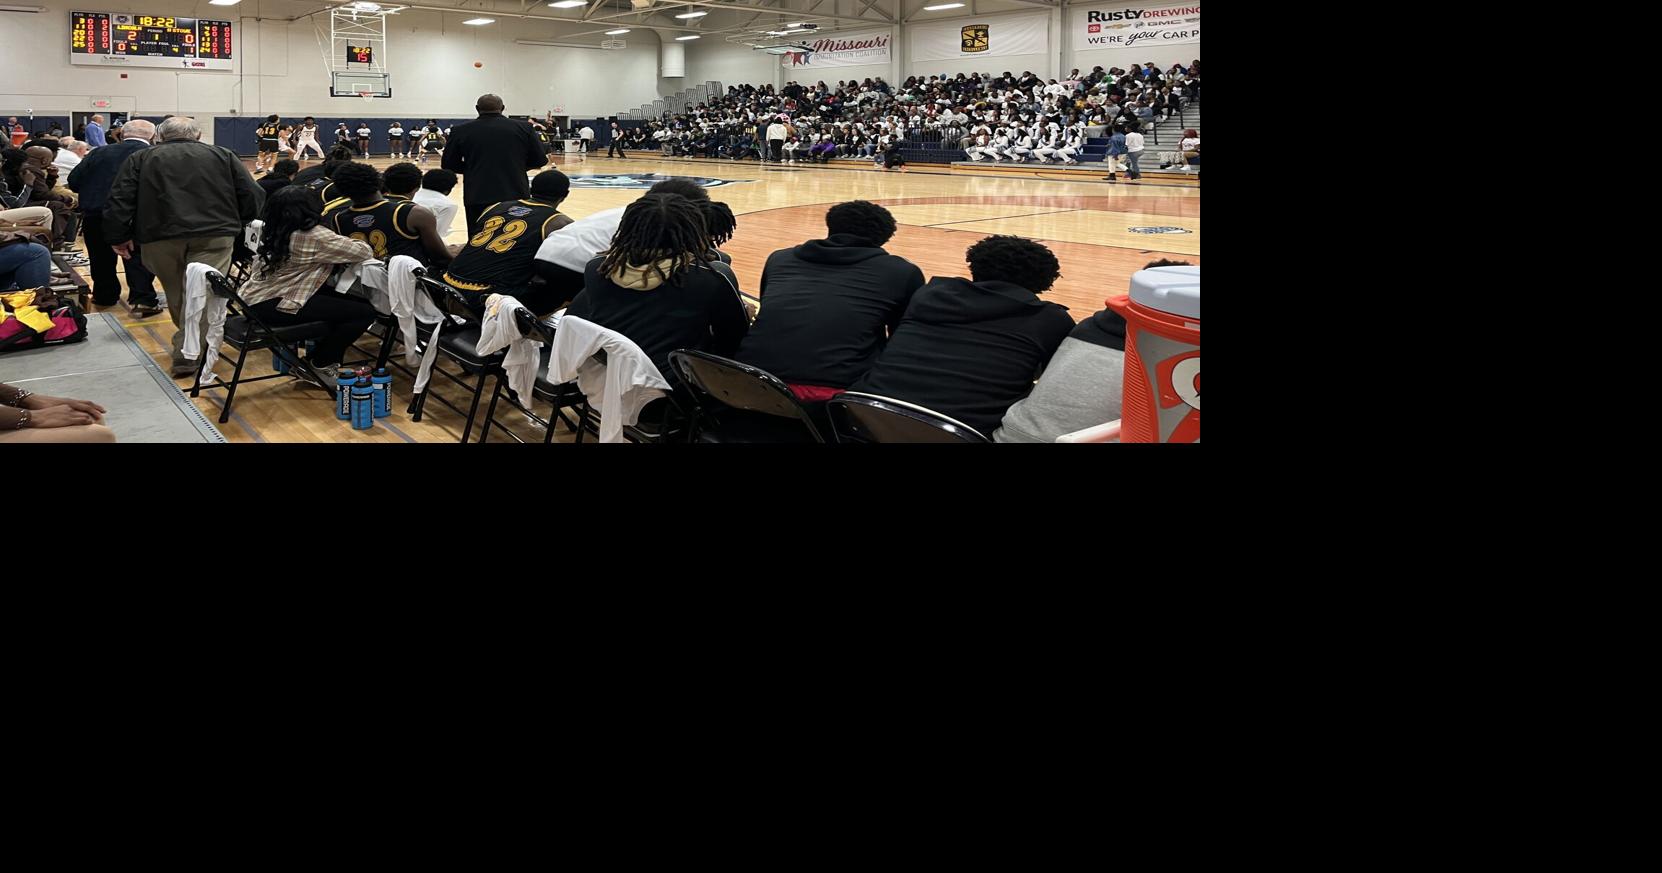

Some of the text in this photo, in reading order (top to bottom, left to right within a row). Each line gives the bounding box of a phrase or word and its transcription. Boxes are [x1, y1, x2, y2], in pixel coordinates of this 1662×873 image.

[1088, 9, 1144, 22] Rusty
[140, 16, 174, 27] 18:22
[128, 31, 136, 40] 2
[185, 34, 194, 43] 0
[1088, 35, 1123, 44] WE'RE
[1125, 30, 1163, 46] your
[1163, 31, 1188, 39] CAR
[813, 34, 889, 53] Missouri
[358, 52, 367, 61] 15
[856, 49, 886, 57] COALITION
[264, 127, 275, 135] 13
